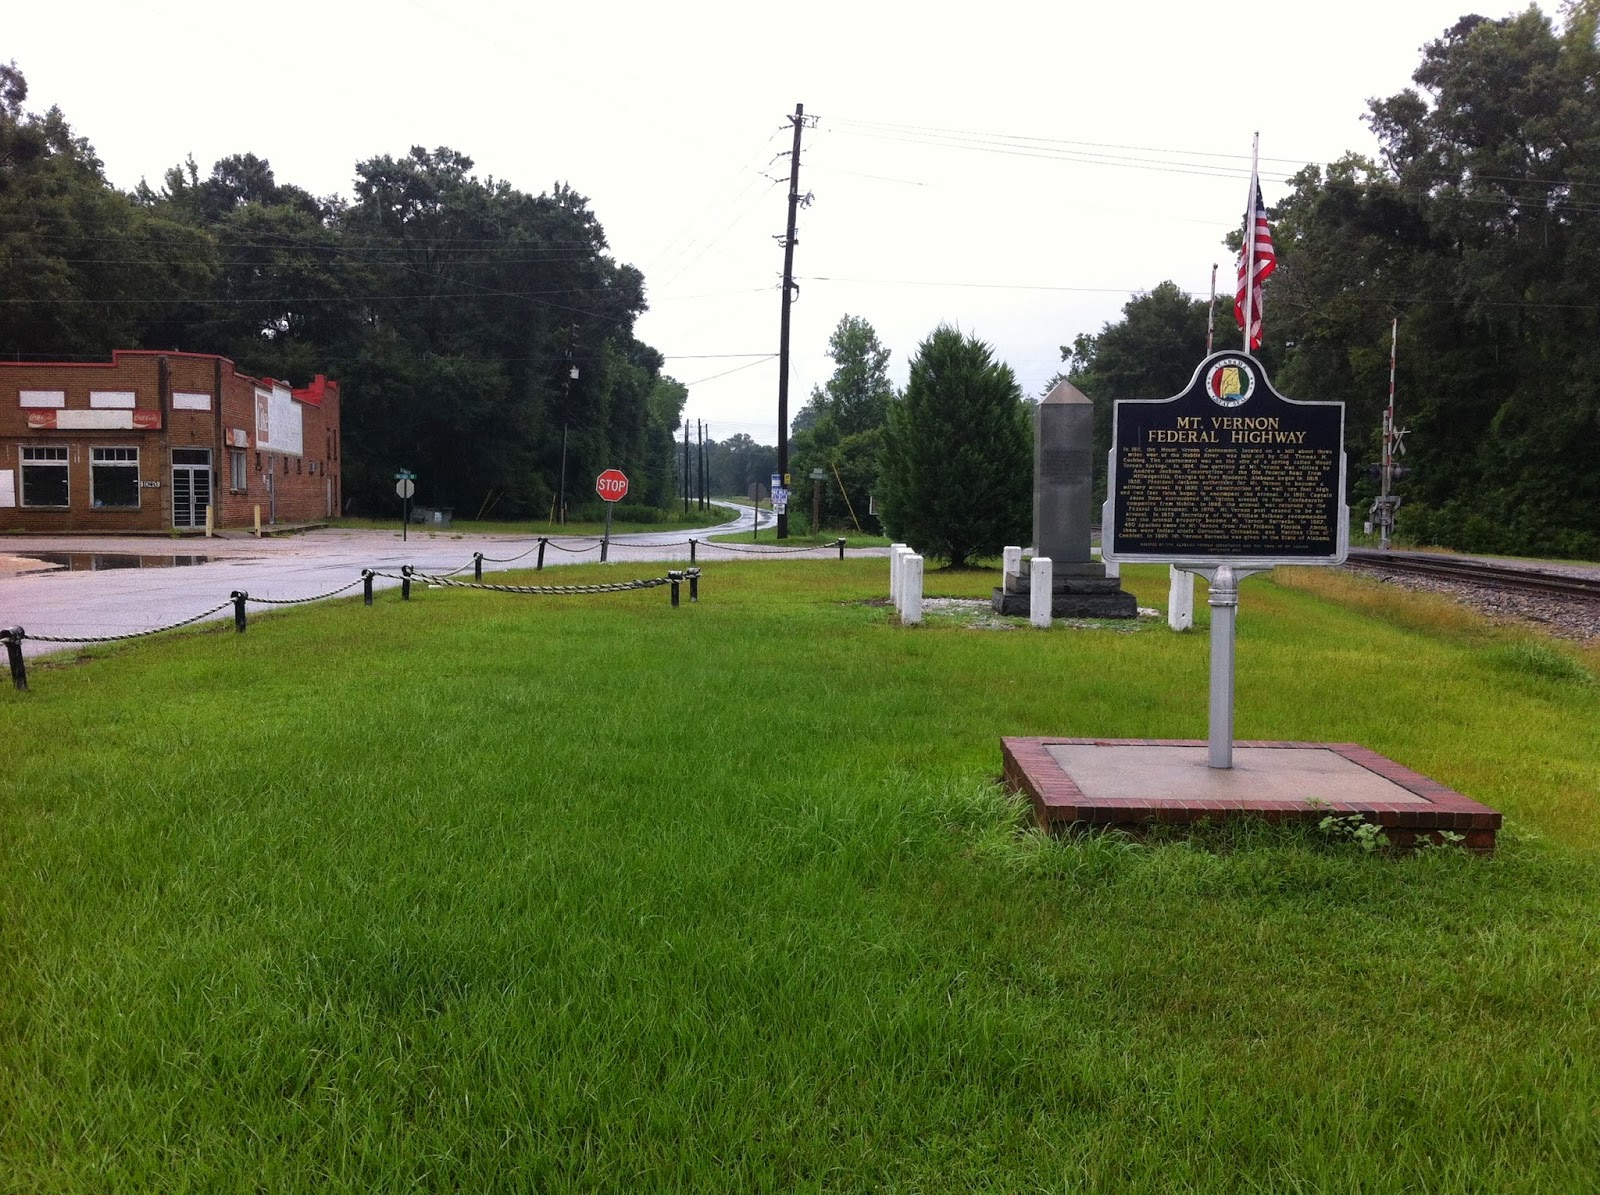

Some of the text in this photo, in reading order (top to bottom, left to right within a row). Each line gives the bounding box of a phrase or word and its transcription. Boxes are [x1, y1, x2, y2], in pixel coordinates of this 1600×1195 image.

[1177, 417, 1280, 430] MT. VERNON
[1148, 430, 1307, 444] FEDERAL HIGHWAY
[598, 478, 626, 492] STOP
